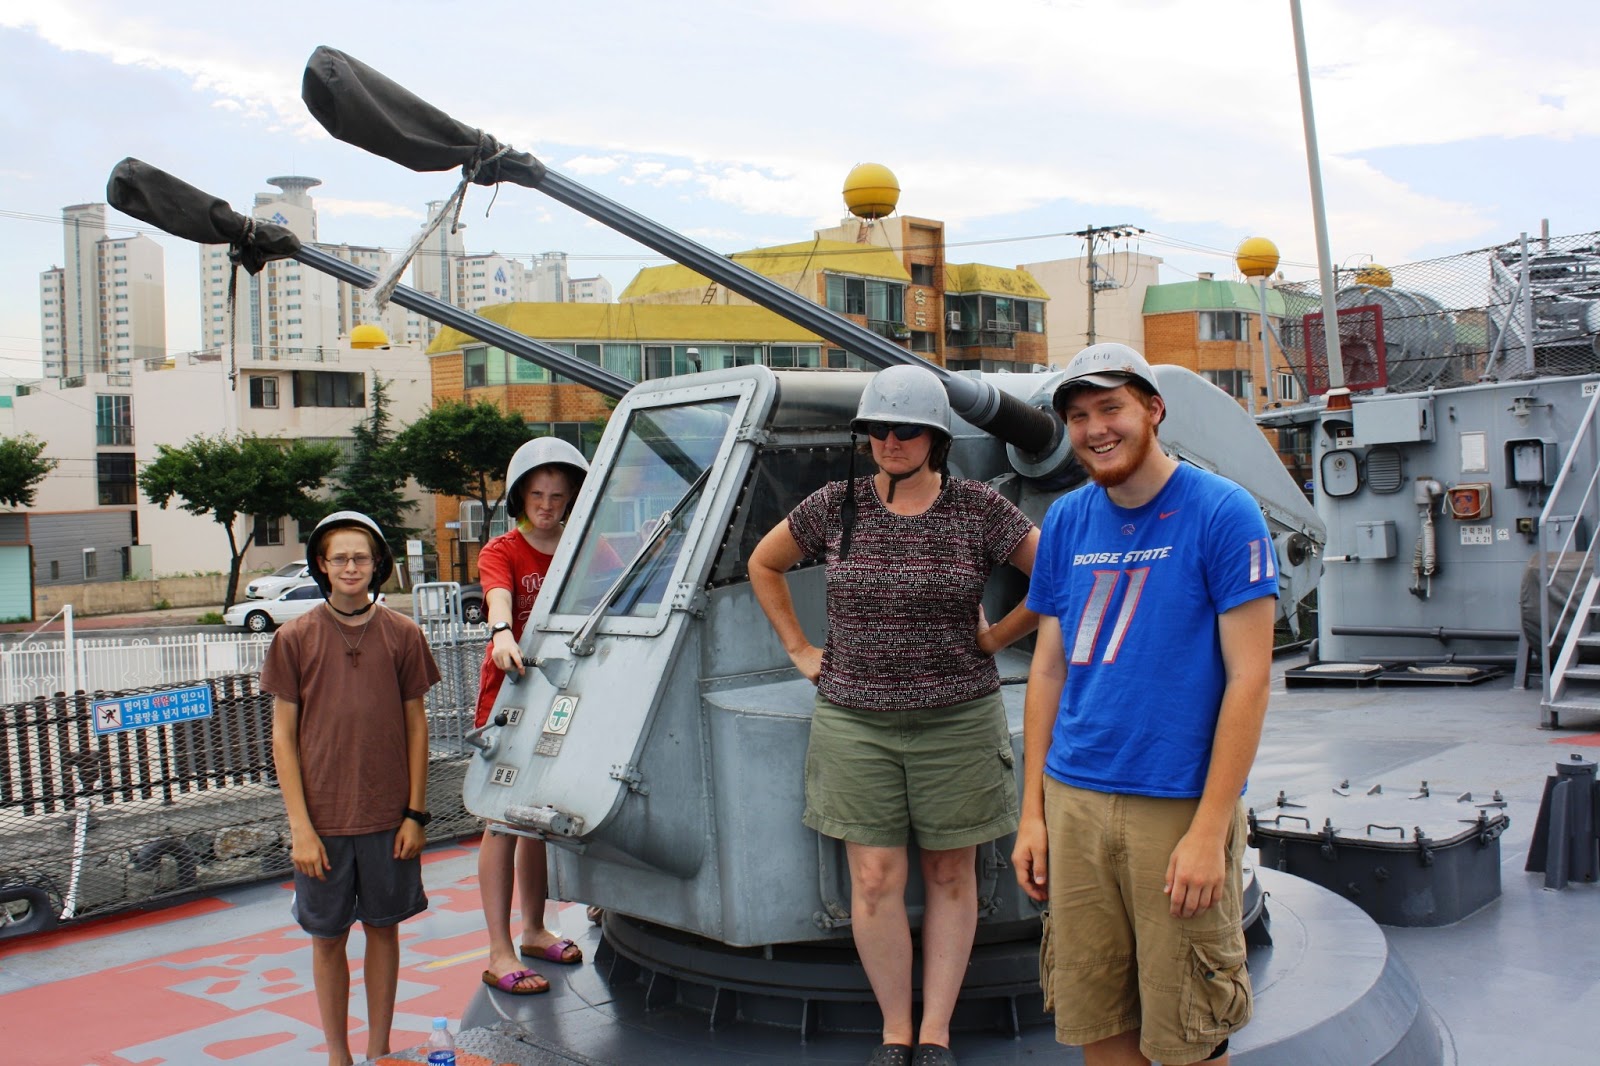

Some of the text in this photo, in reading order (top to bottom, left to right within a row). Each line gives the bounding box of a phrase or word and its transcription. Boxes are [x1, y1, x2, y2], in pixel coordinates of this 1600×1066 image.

[1073, 546, 1173, 566] BOISE STATE
[1248, 538, 1275, 583] 11
[1071, 567, 1150, 665] 11
[124, 690, 205, 713] 떨어질 위험이 있으니
[125, 704, 207, 725] 그물망을 넘지 마세요
